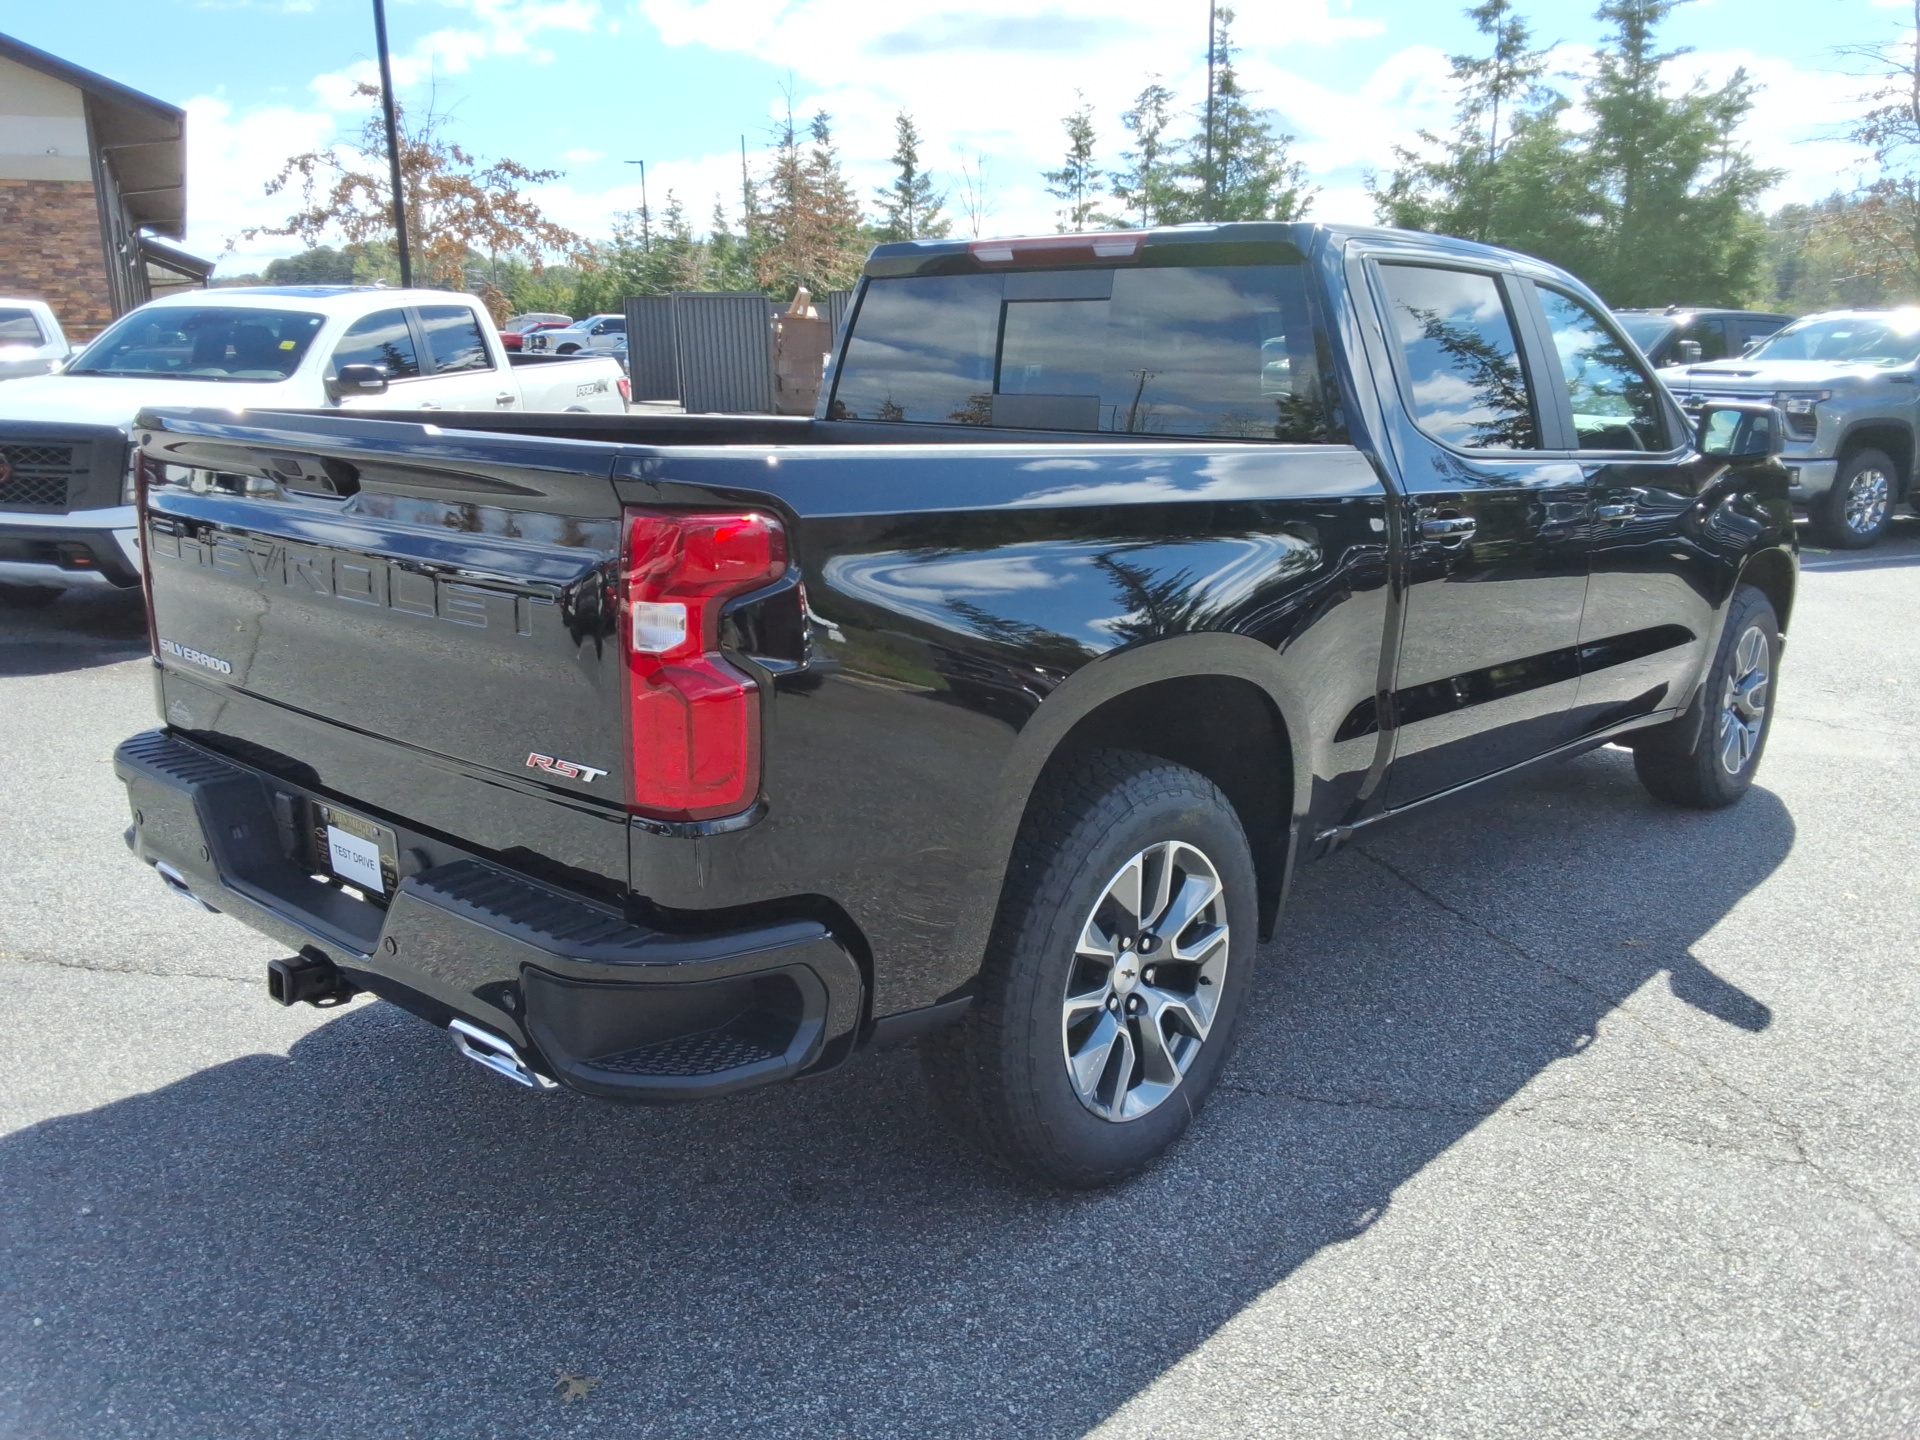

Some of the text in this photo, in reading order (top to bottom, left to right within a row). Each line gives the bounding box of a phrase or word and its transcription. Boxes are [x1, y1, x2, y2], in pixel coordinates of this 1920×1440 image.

[151, 517, 555, 636] CHEVROLET
[160, 639, 232, 674] SILVERADO
[526, 752, 608, 782] RST
[333, 844, 352, 860] TEST
[353, 853, 376, 871] DRIVE
